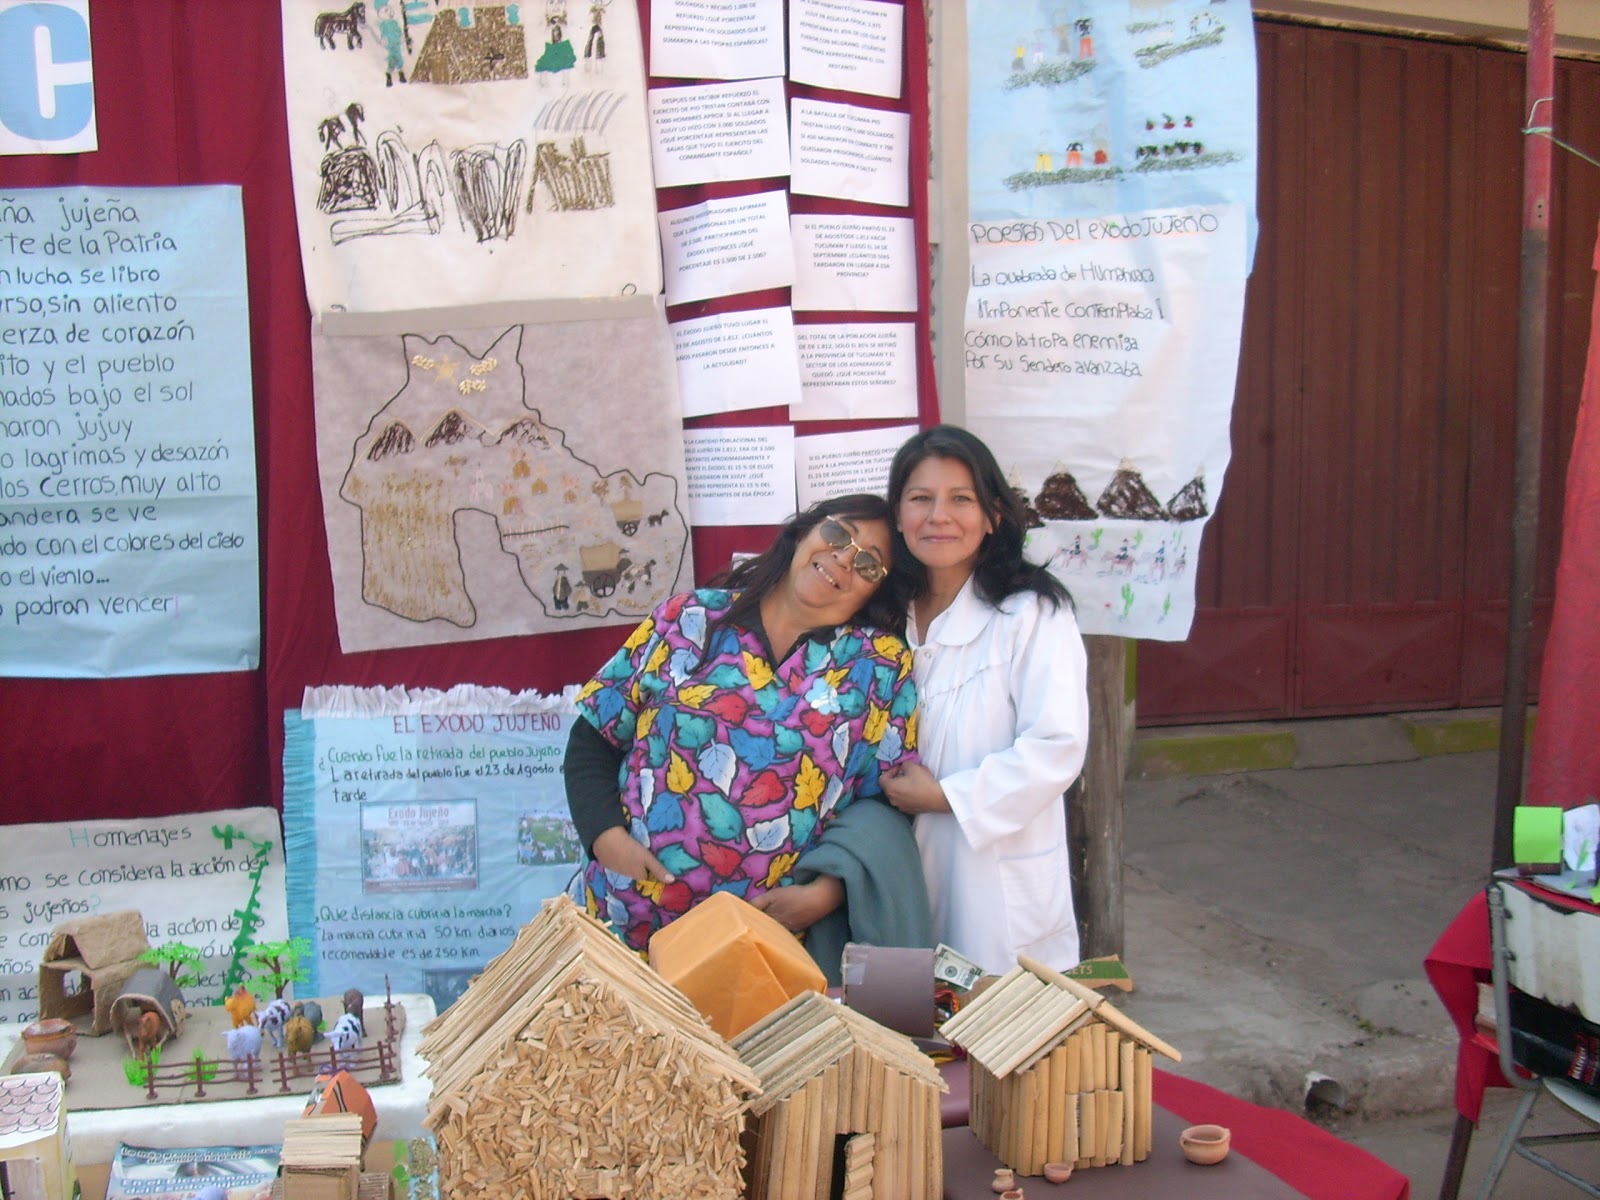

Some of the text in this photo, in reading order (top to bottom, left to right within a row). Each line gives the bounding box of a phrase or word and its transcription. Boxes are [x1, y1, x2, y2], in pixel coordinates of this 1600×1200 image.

[0, 197, 140, 232] ña jujeña
[1047, 218, 1081, 241] Del
[0, 230, 178, 256] te de la Patria
[17, 266, 72, 285] lucha
[80, 270, 106, 284] se
[111, 266, 161, 284] libro
[972, 264, 991, 287] La
[1060, 264, 1077, 281] de
[93, 293, 178, 314] aliento
[66, 323, 91, 343] de
[102, 319, 195, 342] corazón
[964, 330, 1013, 348] Cómo
[1073, 333, 1139, 352] enemiga
[43, 360, 55, 384] y
[65, 355, 86, 375] el
[97, 353, 175, 382] pueblo
[965, 350, 989, 369] Por
[69, 383, 122, 412] bajo
[134, 382, 151, 403] el
[159, 381, 193, 402] sol
[75, 411, 134, 442] jujuy
[25, 443, 126, 475] lagrimas
[134, 449, 147, 469] y
[151, 438, 229, 463] desazón
[121, 474, 166, 500] muy
[176, 471, 221, 492] alto
[91, 506, 117, 524] se
[128, 505, 157, 522] ve
[36, 536, 77, 556] con
[82, 534, 98, 554] el
[178, 533, 203, 550] del
[207, 531, 245, 549] cielo
[19, 567, 36, 585] el
[394, 712, 561, 734] EL EXODO JUJEÑO
[375, 744, 396, 762] fue
[399, 745, 413, 761] la
[416, 745, 463, 760] retirada
[469, 744, 486, 759] del
[490, 747, 524, 763] pueblo
[354, 768, 403, 781] retirada
[406, 768, 420, 779] del
[454, 765, 470, 778] fue
[485, 764, 500, 777] 23
[503, 764, 515, 776] de
[332, 787, 367, 803] tarde
[67, 826, 192, 849] Homenajes
[45, 872, 70, 888] se
[170, 859, 185, 878] la
[351, 906, 403, 921] distancia
[453, 905, 465, 918] la
[467, 903, 512, 918] marcha?
[337, 928, 375, 940] marcha
[434, 925, 452, 939] 50
[322, 947, 395, 960] recomendable
[401, 948, 416, 959] es
[419, 948, 432, 959] de
[435, 947, 457, 958] 250
